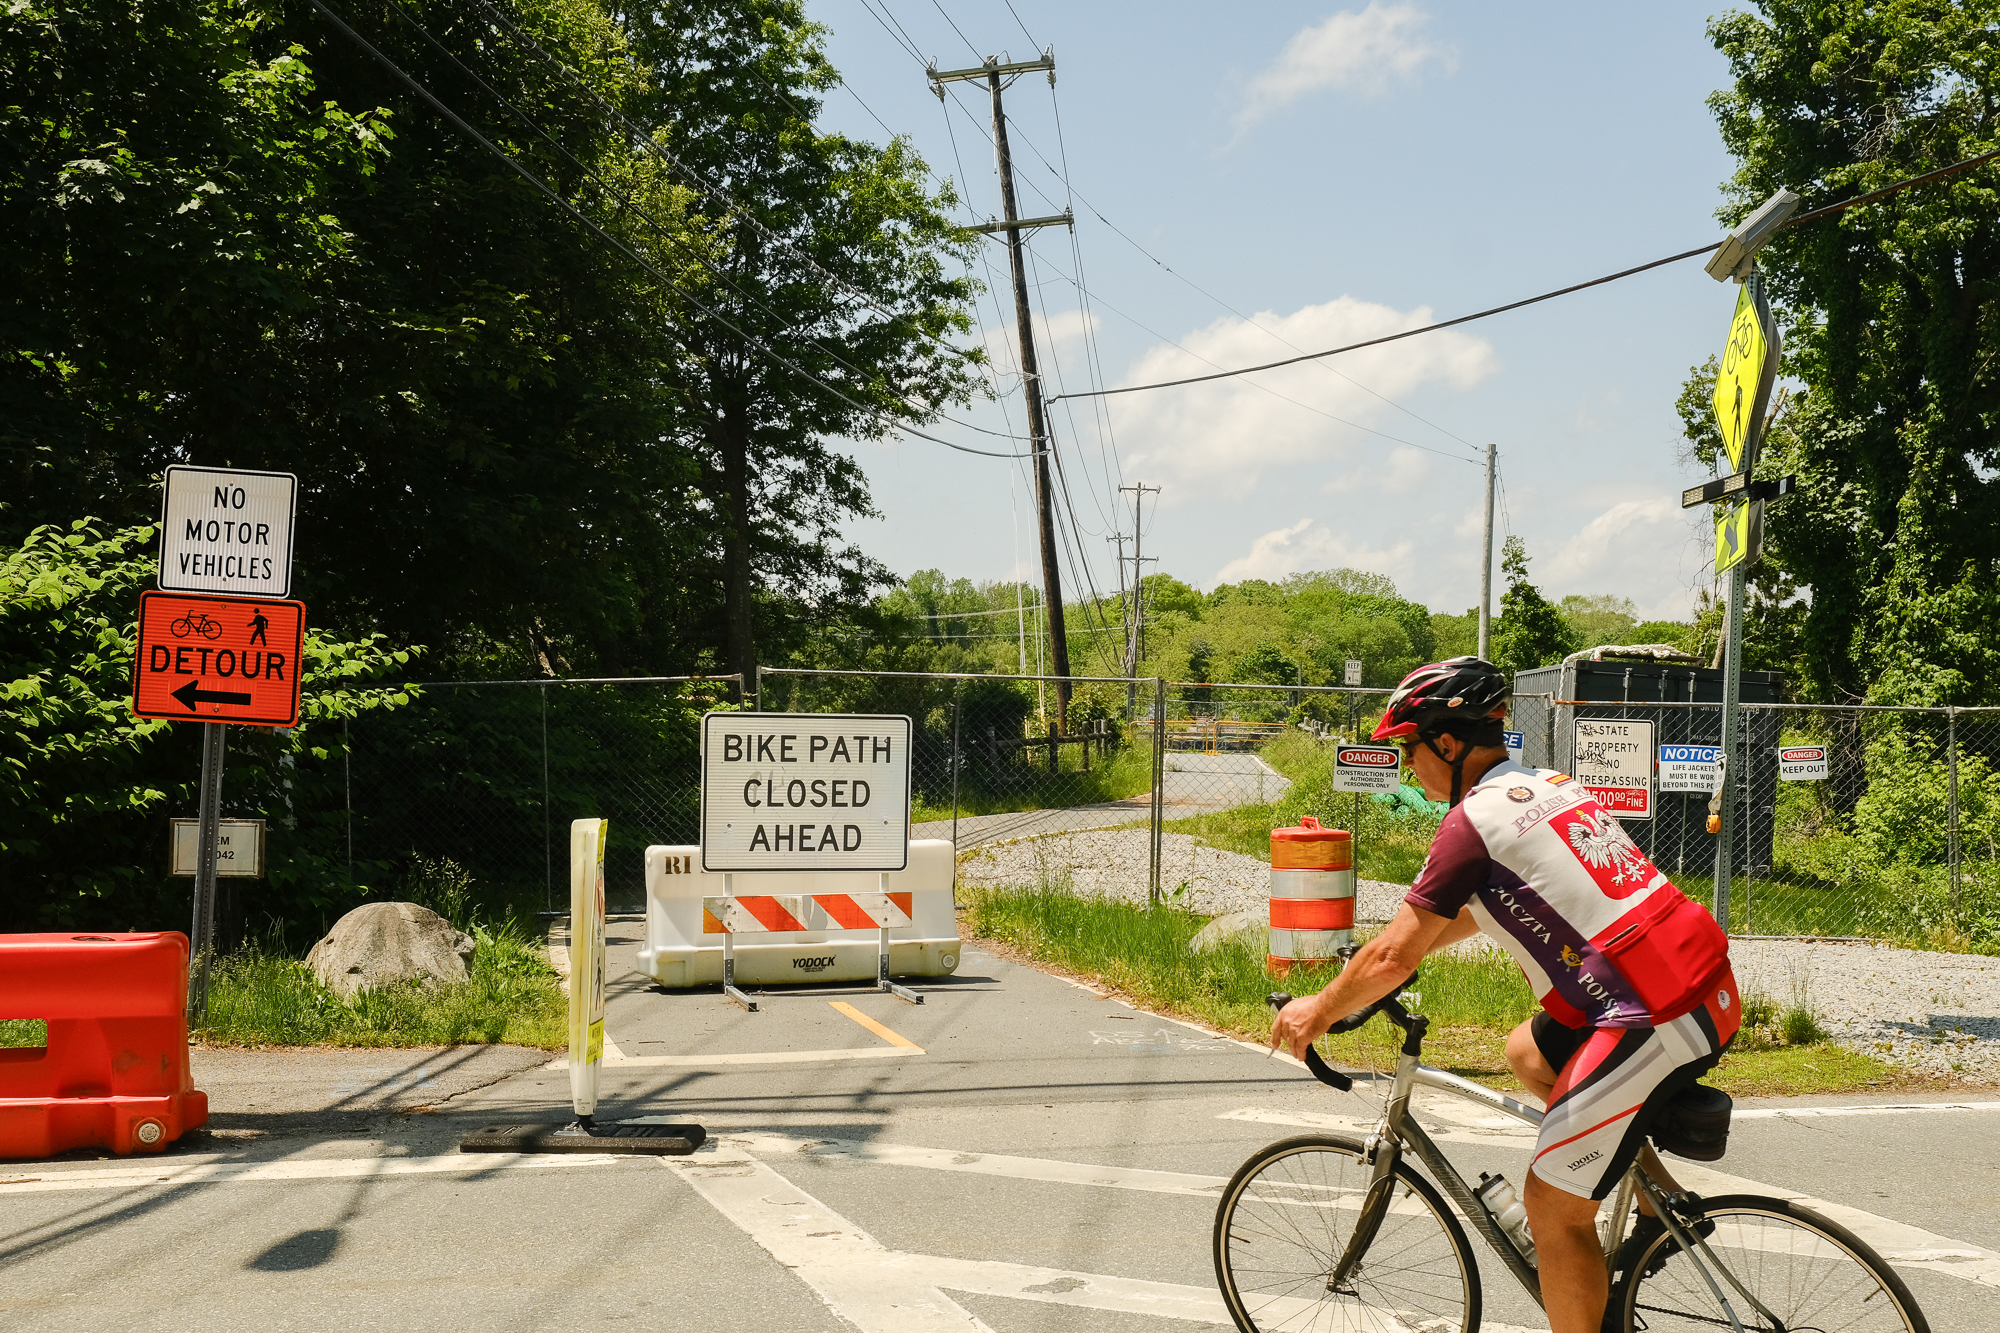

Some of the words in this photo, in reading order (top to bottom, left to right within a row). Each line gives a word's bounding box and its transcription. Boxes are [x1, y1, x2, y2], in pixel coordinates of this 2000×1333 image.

[214, 486, 246, 510] NO
[185, 518, 270, 545] MOTOR
[179, 552, 273, 580] VEHICLES
[150, 645, 286, 681] DETOUR
[1347, 662, 1360, 670] KEEP
[1599, 726, 1629, 735] STATE
[724, 734, 798, 763] BIKE
[809, 735, 891, 764] PATH
[1587, 742, 1640, 752] PROPERTY
[1787, 751, 1819, 759] DANGER
[1346, 752, 1390, 764] DANGER
[1606, 759, 1620, 769] NO
[1782, 765, 1805, 774] KEEP
[1806, 764, 1826, 773] OUT
[1579, 775, 1648, 787] TRESPASSING
[1662, 781, 1689, 789] BEYOND
[743, 779, 871, 808] CLOSED
[1588, 789, 1615, 807] 500
[1626, 797, 1644, 808] FINE
[1511, 795, 1570, 833] POLISH
[748, 824, 862, 852] AHEAD
[665, 855, 691, 875] RI
[792, 956, 836, 969] YODOCK
[1577, 972, 1623, 1022] POLSK
[1567, 1149, 1600, 1170] VOOFLY
